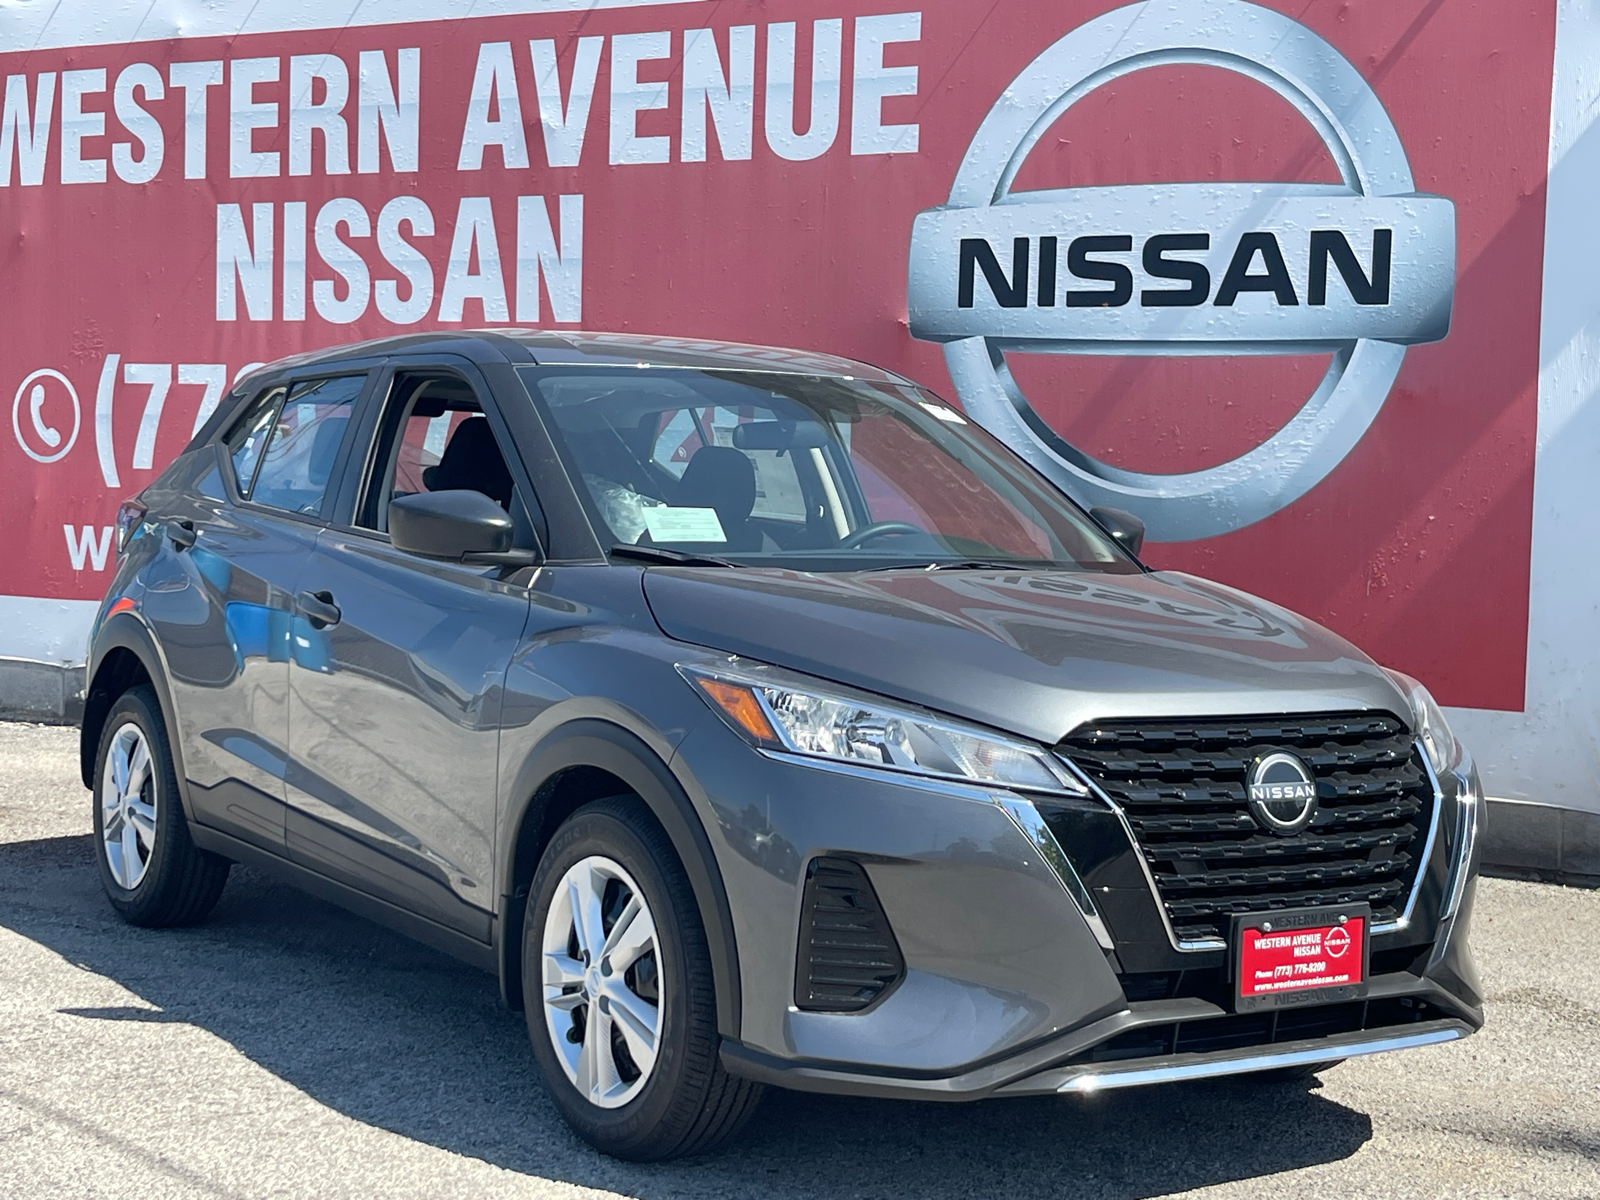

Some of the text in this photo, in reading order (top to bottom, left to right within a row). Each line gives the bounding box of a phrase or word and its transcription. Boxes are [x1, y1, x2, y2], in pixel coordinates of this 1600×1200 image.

[0, 12, 922, 187] WESTERN AVENUE
[216, 194, 583, 324] NISSAN
[957, 228, 1392, 308] NISSAN
[1251, 785, 1315, 800] NISSAN
[1271, 913, 1317, 928] WESTERN
[1254, 933, 1321, 949] WESTERN AVENUE
[1324, 938, 1351, 946] NISSAN
[1293, 945, 1321, 957] NISSAN
[1274, 964, 1293, 979] (773)
[1294, 961, 1326, 974] 776-8200
[1275, 988, 1331, 1006] NISSAN
